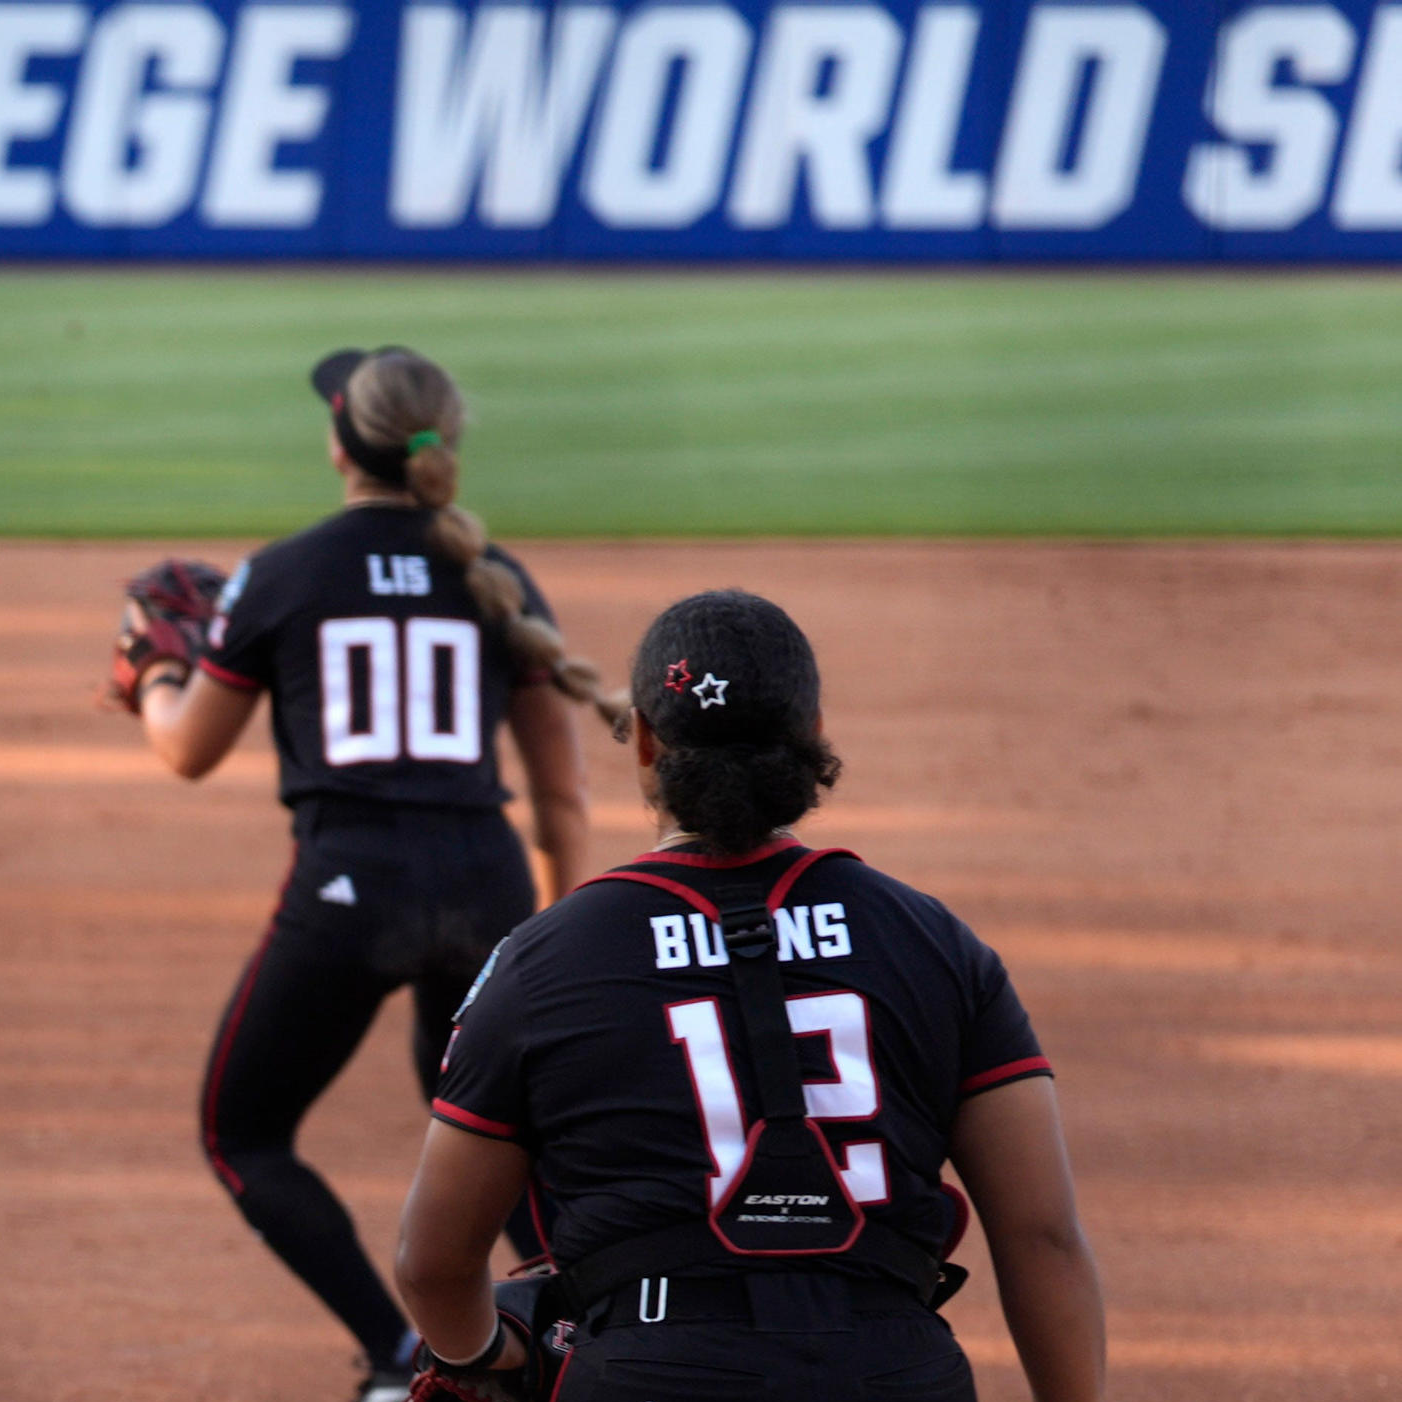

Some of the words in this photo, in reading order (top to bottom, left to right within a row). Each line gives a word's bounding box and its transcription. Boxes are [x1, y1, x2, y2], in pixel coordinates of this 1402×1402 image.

[390, 2, 1168, 230] WORLD
[366, 553, 432, 596] LIS
[318, 616, 482, 766] 00
[649, 902, 853, 969] BUNS
[743, 1194, 830, 1206] EASTON
